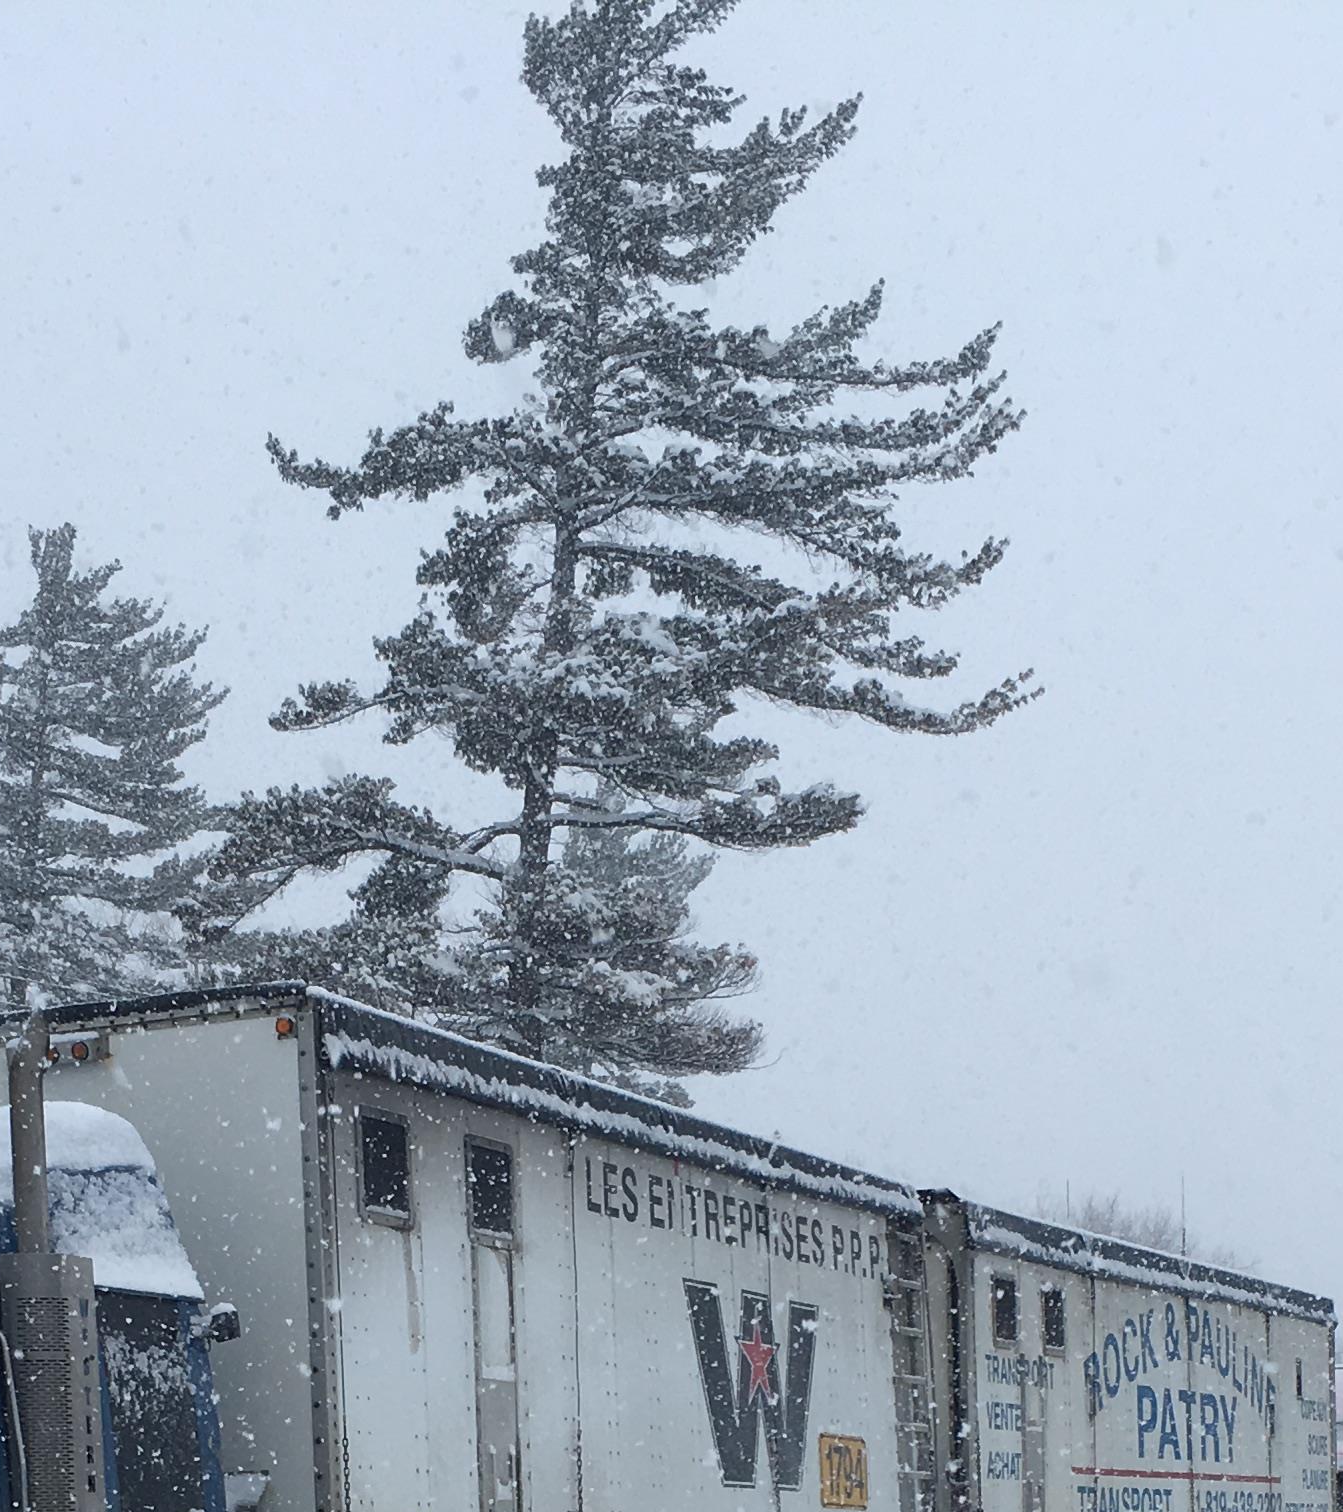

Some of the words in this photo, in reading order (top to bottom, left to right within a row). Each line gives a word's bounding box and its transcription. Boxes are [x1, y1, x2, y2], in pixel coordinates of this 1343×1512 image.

[585, 1156, 639, 1222] LES
[648, 1174, 824, 1267] ENTREPRISES
[985, 1354, 1054, 1389] TRANSPORT
[1084, 1307, 1159, 1415] ROCK
[1165, 1302, 1182, 1361] &
[986, 1401, 1022, 1432] VENTE
[1136, 1384, 1238, 1463] PATRY
[987, 1451, 1022, 1481] ACHAT
